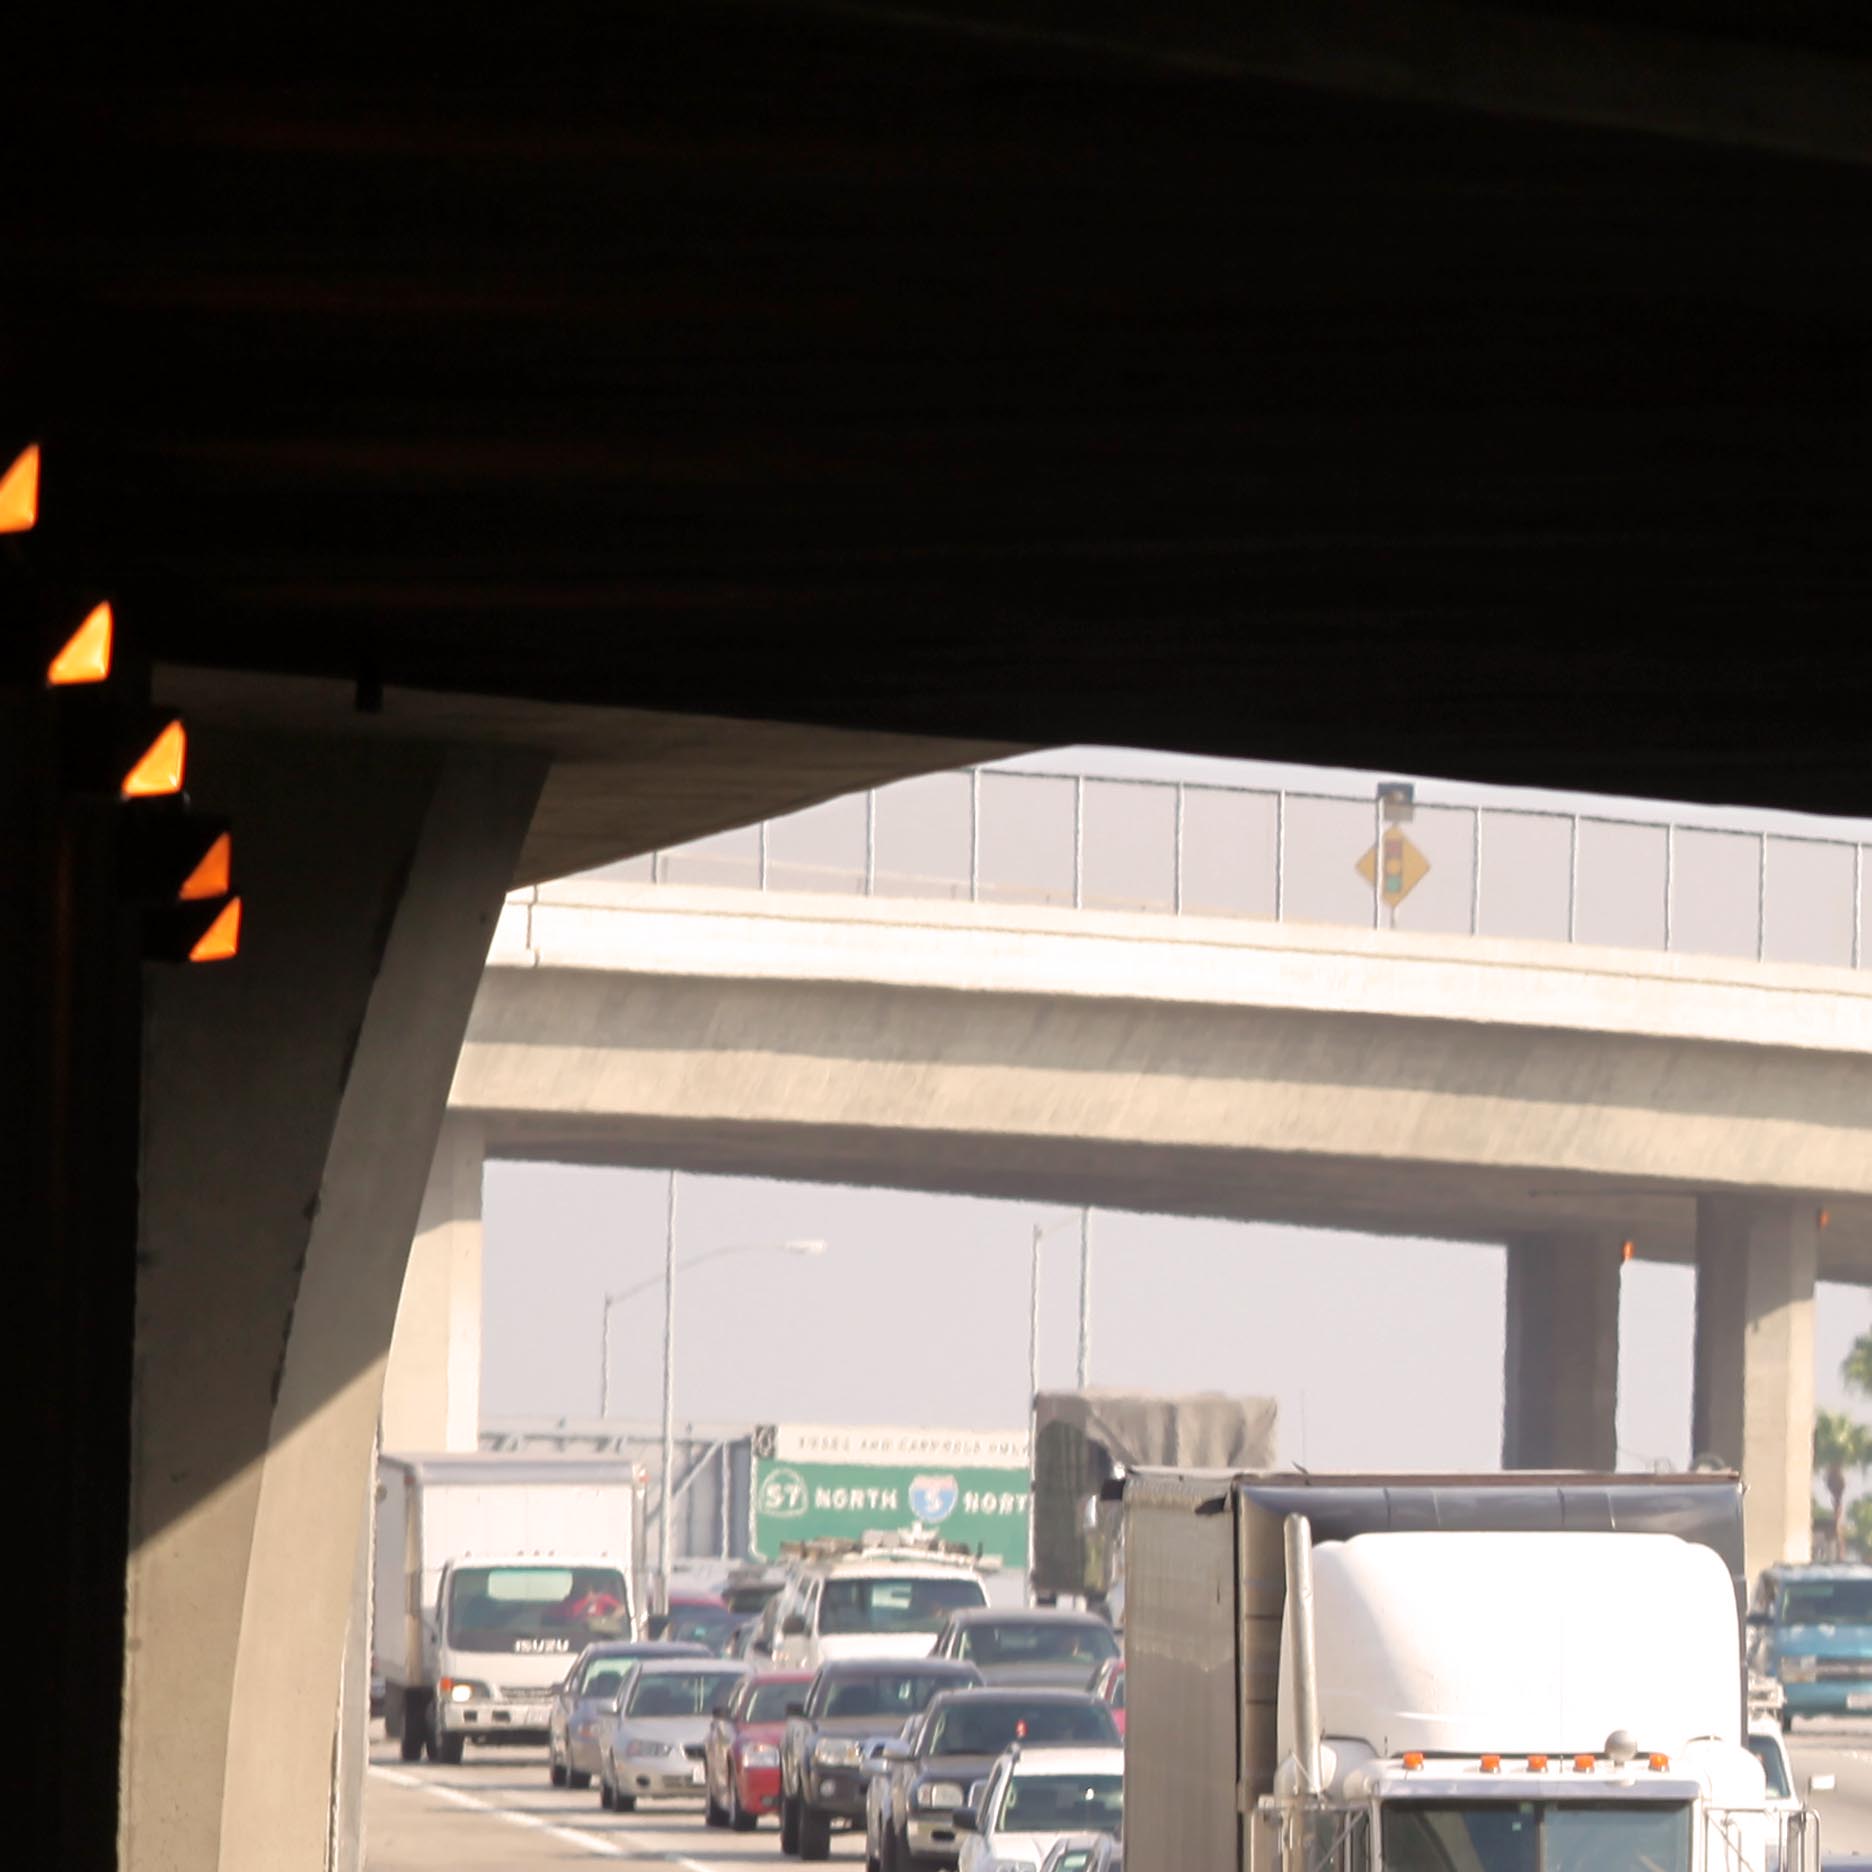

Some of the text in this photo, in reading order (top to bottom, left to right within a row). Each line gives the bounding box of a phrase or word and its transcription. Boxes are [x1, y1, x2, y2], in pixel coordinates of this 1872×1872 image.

[766, 1483, 801, 1508] 57
[814, 1484, 898, 1511] NORTH
[962, 1490, 1028, 1515] NORT
[515, 1638, 570, 1653] ISUZU
